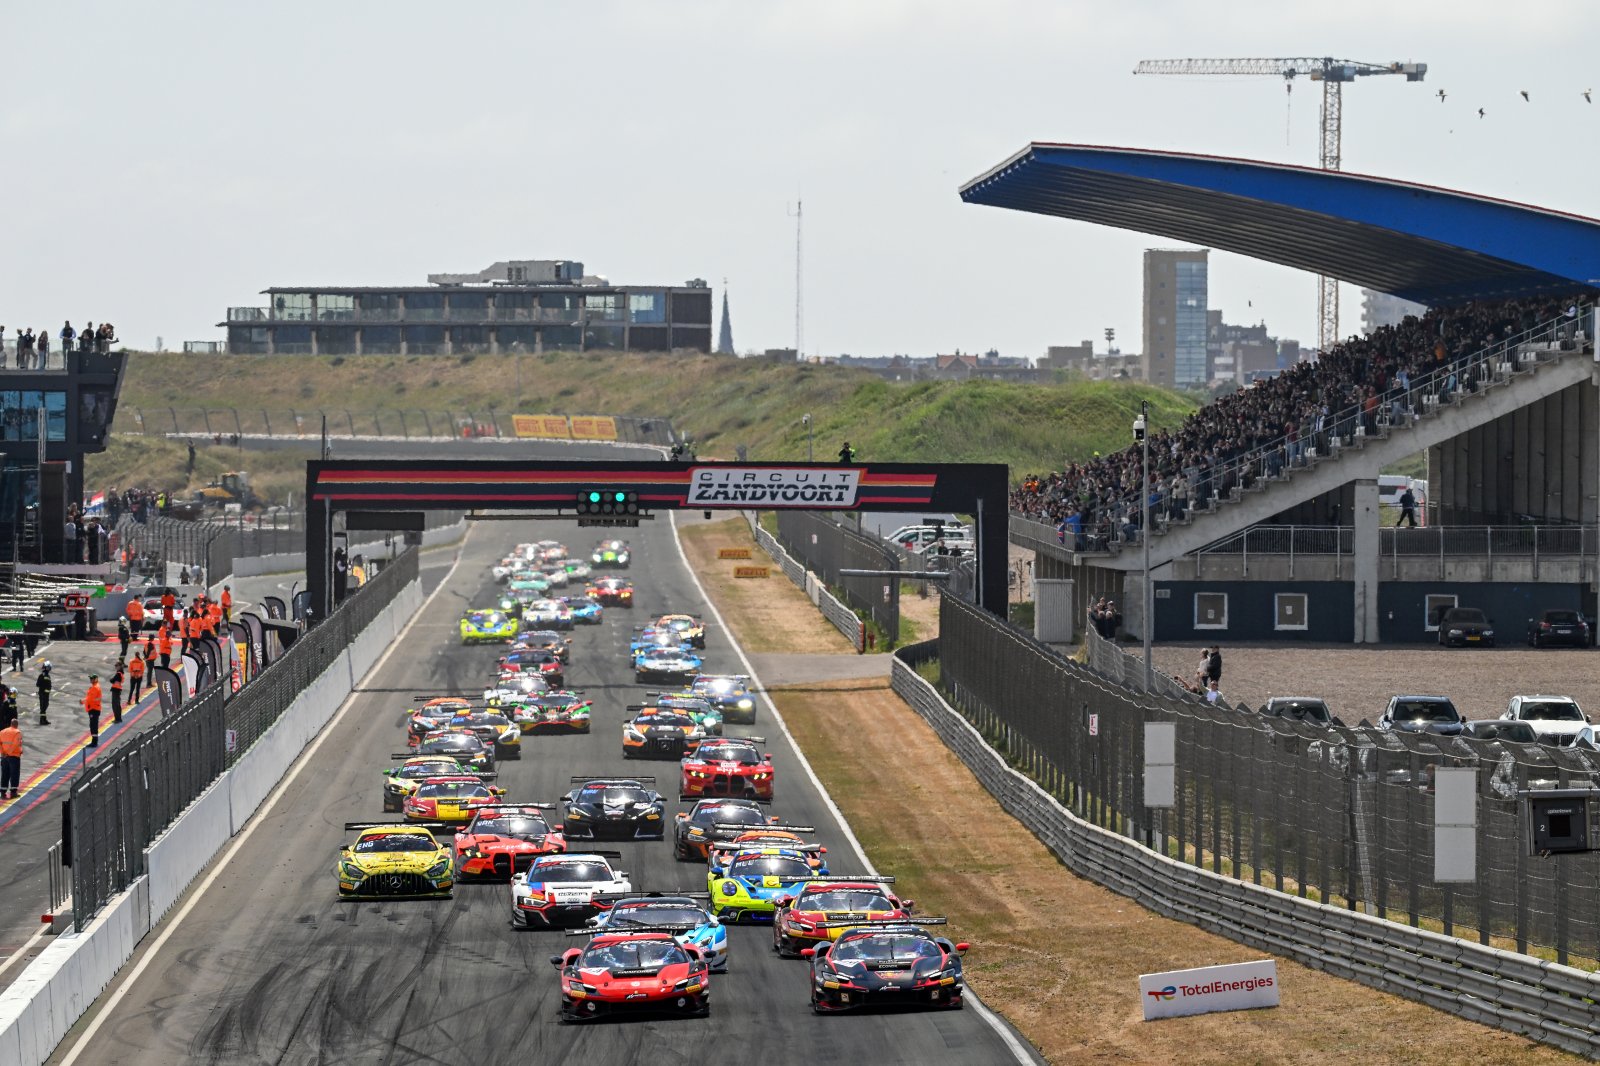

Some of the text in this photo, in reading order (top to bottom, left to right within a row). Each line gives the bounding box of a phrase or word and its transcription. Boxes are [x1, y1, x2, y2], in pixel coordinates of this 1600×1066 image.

[700, 472, 850, 482] CIRCUIT
[695, 483, 850, 502] ZANDVOORT
[1540, 824, 1545, 832] 2
[356, 840, 374, 850] ENG
[1179, 977, 1273, 997] TotalEnergies
